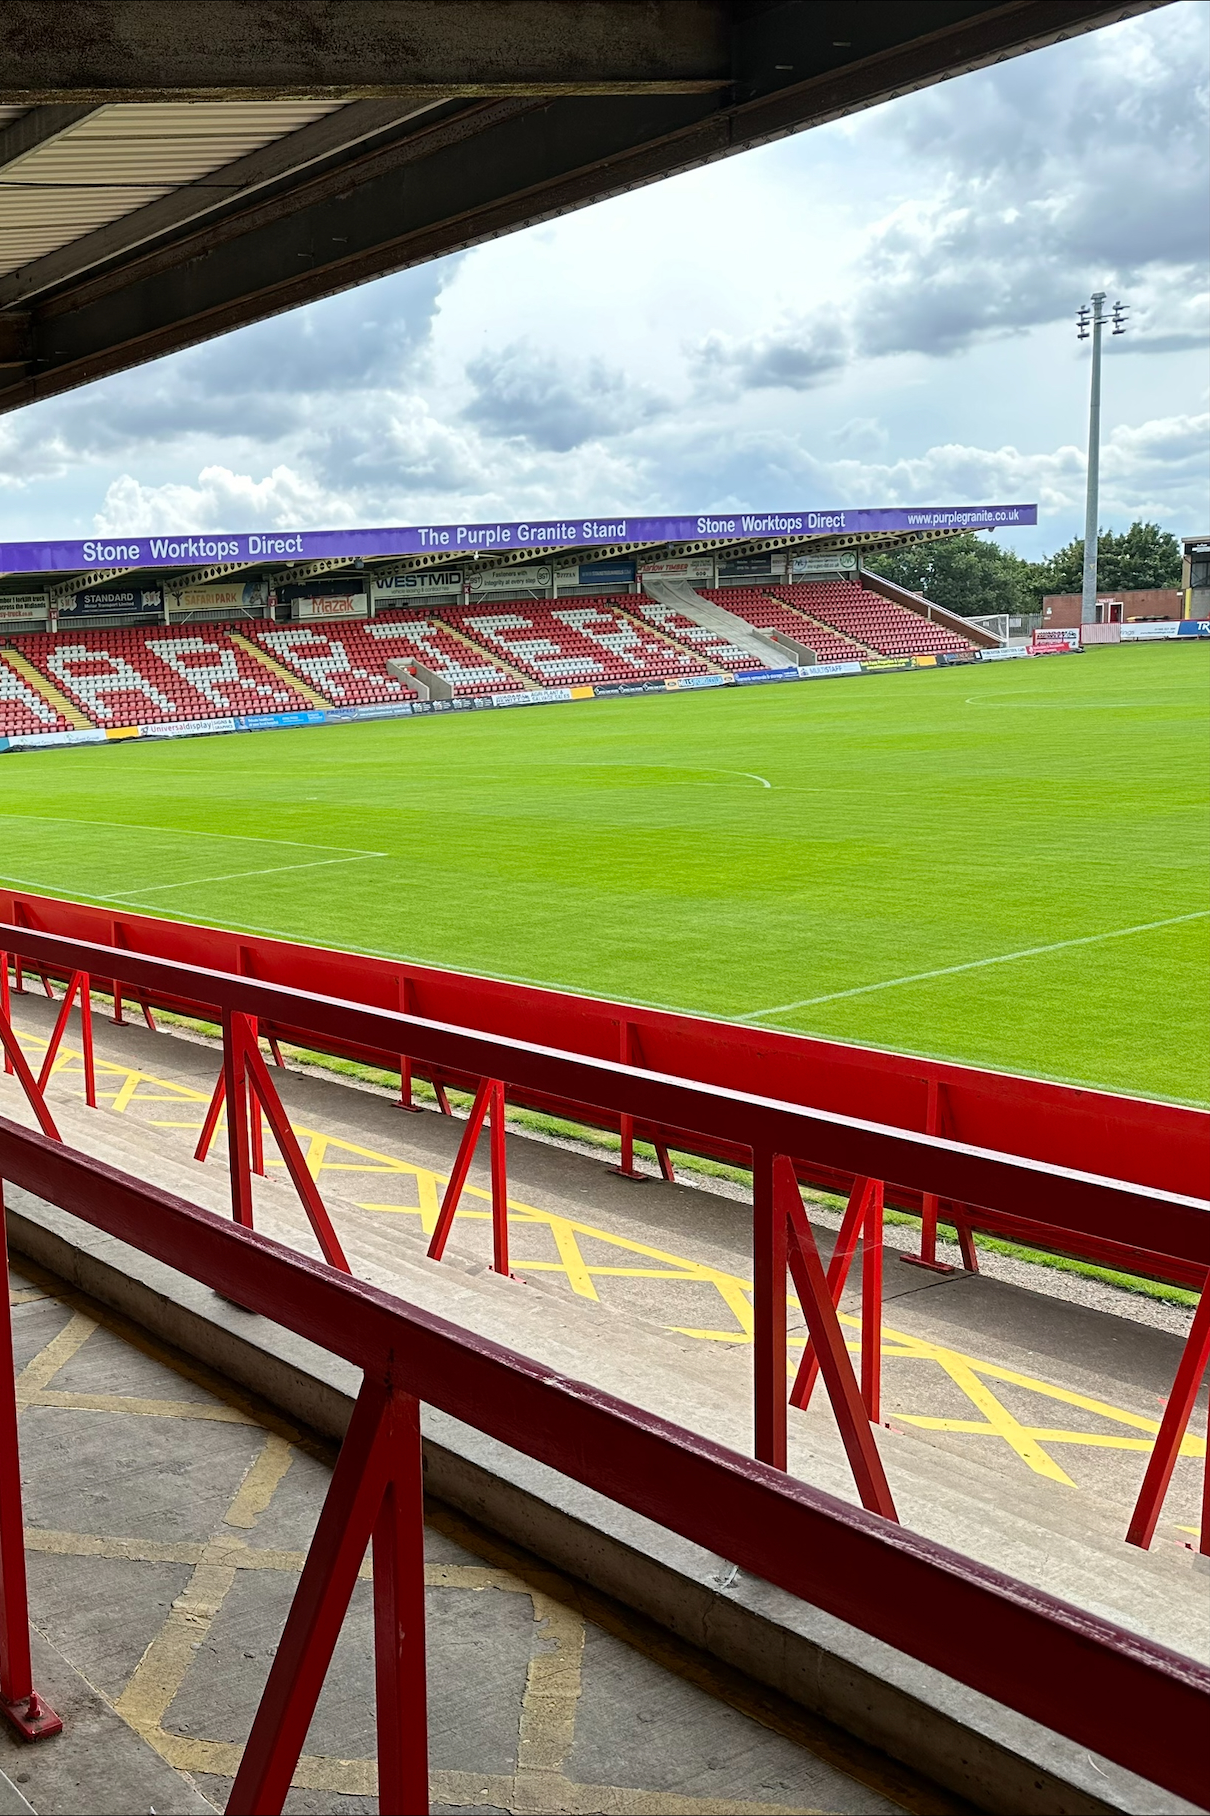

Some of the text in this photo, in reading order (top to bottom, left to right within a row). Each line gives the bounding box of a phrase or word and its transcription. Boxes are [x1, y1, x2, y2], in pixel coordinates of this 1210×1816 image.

[697, 512, 846, 534] Stone Worktops Direct
[908, 509, 1019, 526] www.purplegranite.co.uk
[418, 520, 626, 547] The Purple Granite Stand
[83, 535, 304, 562] Stone Worktops Direct
[376, 572, 461, 589] WESTMID
[84, 593, 134, 604] STANDARD
[184, 593, 237, 606] SAFARI PARK
[312, 597, 355, 614] Mazak
[809, 665, 843, 674] MULTISTAFF
[150, 720, 212, 733] Universaldisplay
